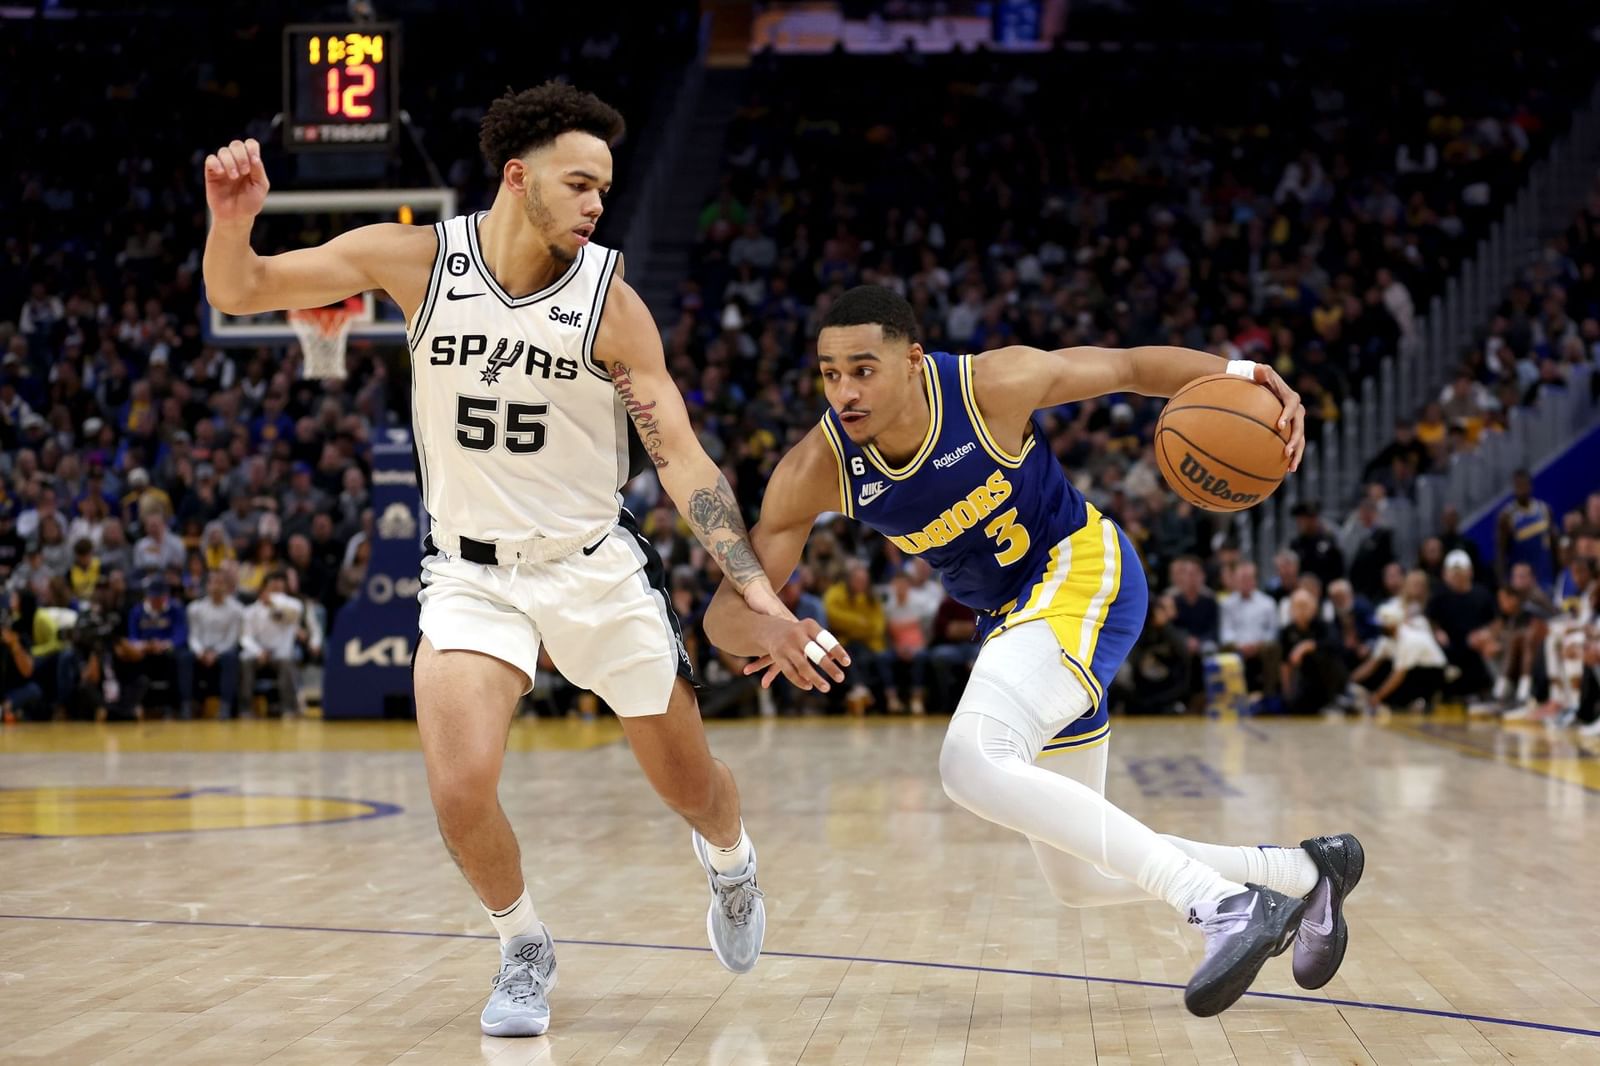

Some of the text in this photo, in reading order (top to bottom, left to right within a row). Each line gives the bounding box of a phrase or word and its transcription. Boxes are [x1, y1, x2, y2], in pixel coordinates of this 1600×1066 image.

[309, 33, 384, 66] 11:34
[327, 64, 376, 118] 12
[450, 255, 467, 274] 6
[548, 306, 583, 328] Self.
[430, 335, 578, 386] SPURS
[455, 392, 550, 455] 55
[850, 456, 866, 476] 6
[932, 441, 976, 470] Rakuten
[861, 480, 884, 497] NIKE
[1180, 452, 1261, 503] Wilson
[984, 507, 1031, 568] 3
[345, 636, 413, 666] KI
